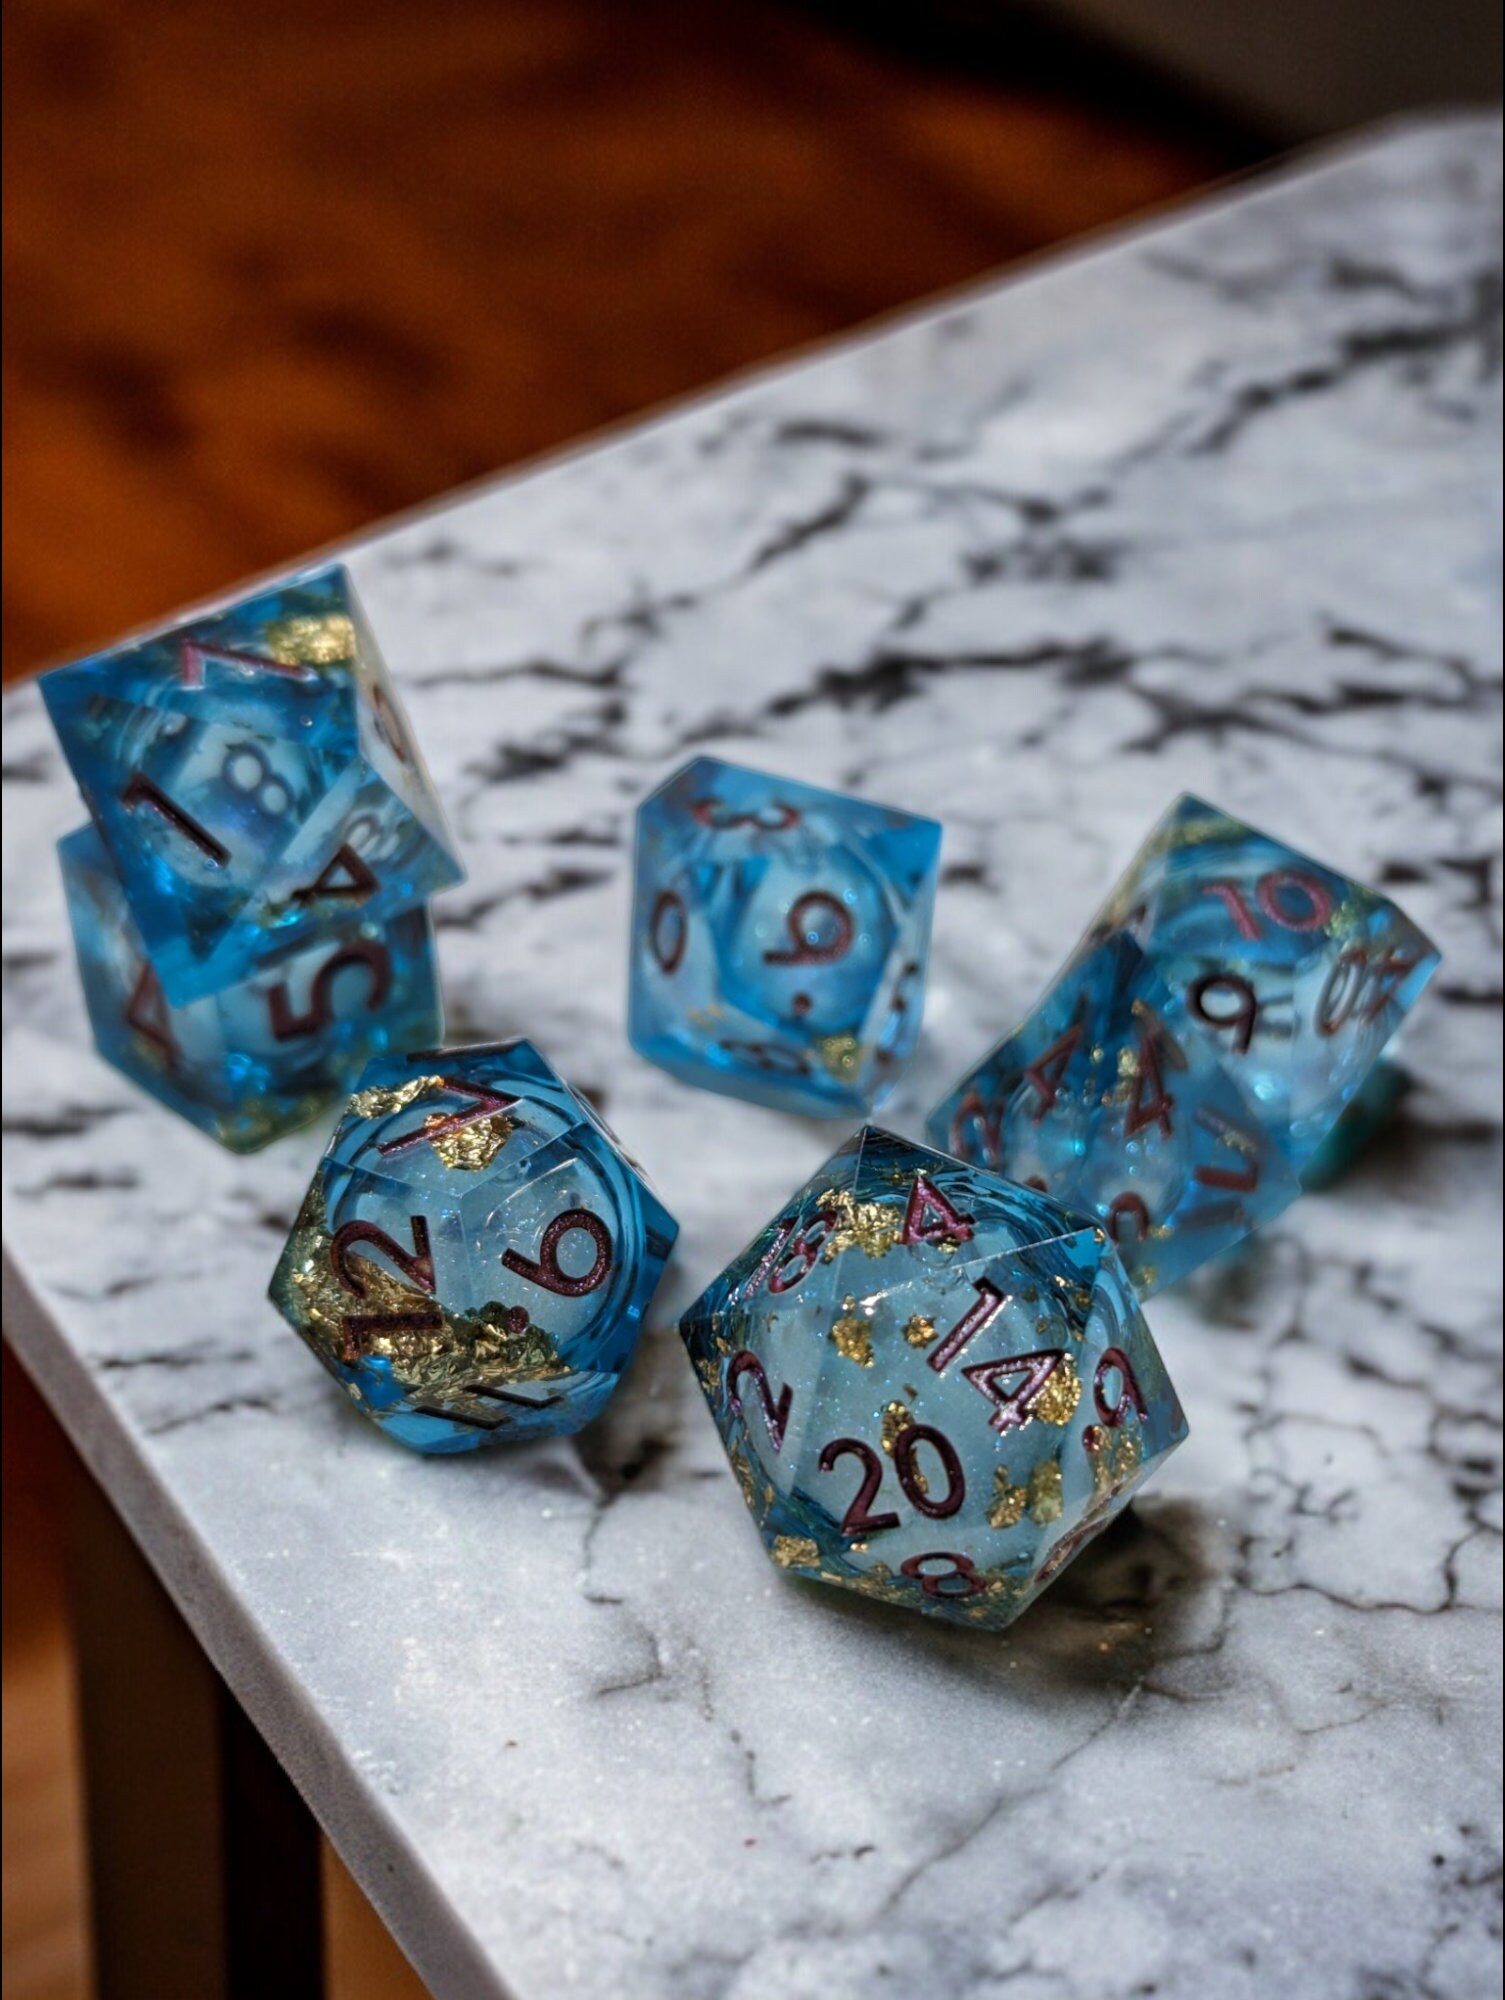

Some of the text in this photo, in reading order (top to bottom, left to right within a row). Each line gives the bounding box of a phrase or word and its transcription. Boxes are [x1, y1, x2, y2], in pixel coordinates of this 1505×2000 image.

[122, 771, 234, 869] 1
[651, 890, 689, 977] 0
[1200, 868, 1333, 942] 10
[267, 940, 394, 1044] 5
[902, 1174, 976, 1246] 4
[330, 1215, 443, 1361] 12
[726, 1350, 794, 1455] 2
[926, 1276, 1066, 1436] 14
[817, 1423, 967, 1538] 20
[901, 1551, 988, 1599] 8
